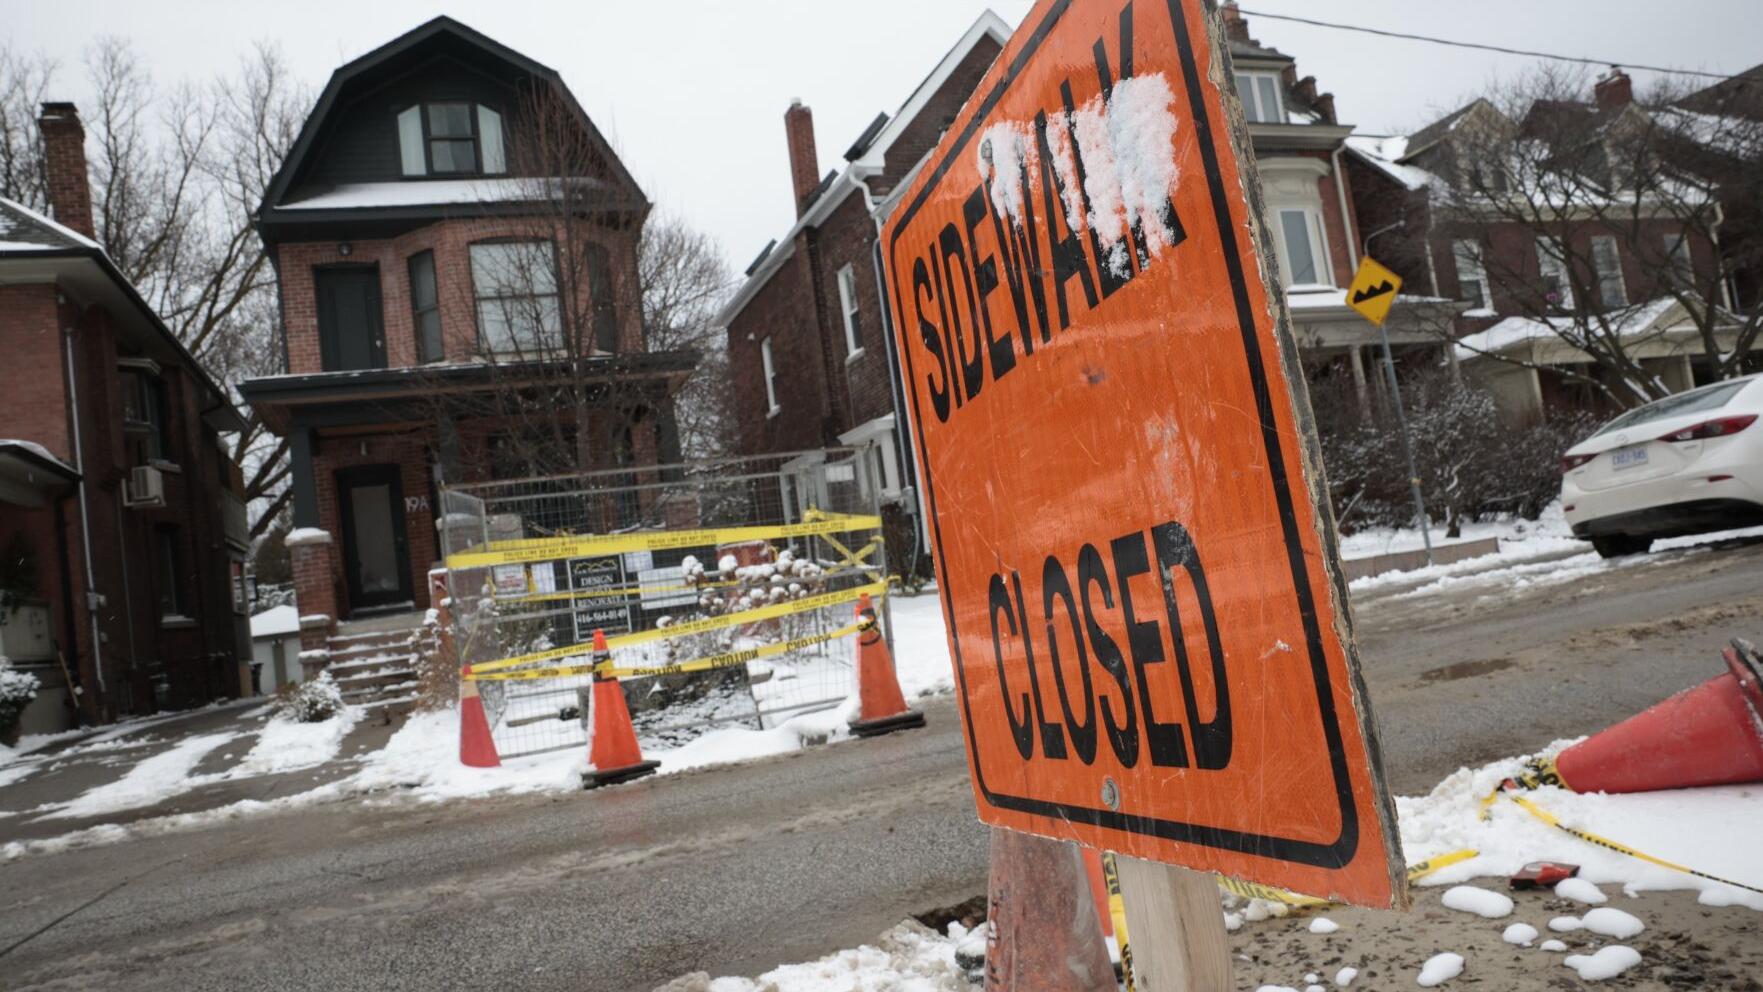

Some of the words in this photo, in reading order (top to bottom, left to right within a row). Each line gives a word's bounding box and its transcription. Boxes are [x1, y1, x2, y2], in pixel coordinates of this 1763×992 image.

[912, 2, 1188, 423] SIDEWALK
[404, 496, 429, 512] 19A
[581, 575, 613, 587] DESIGN
[989, 521, 1233, 770] CLOSED
